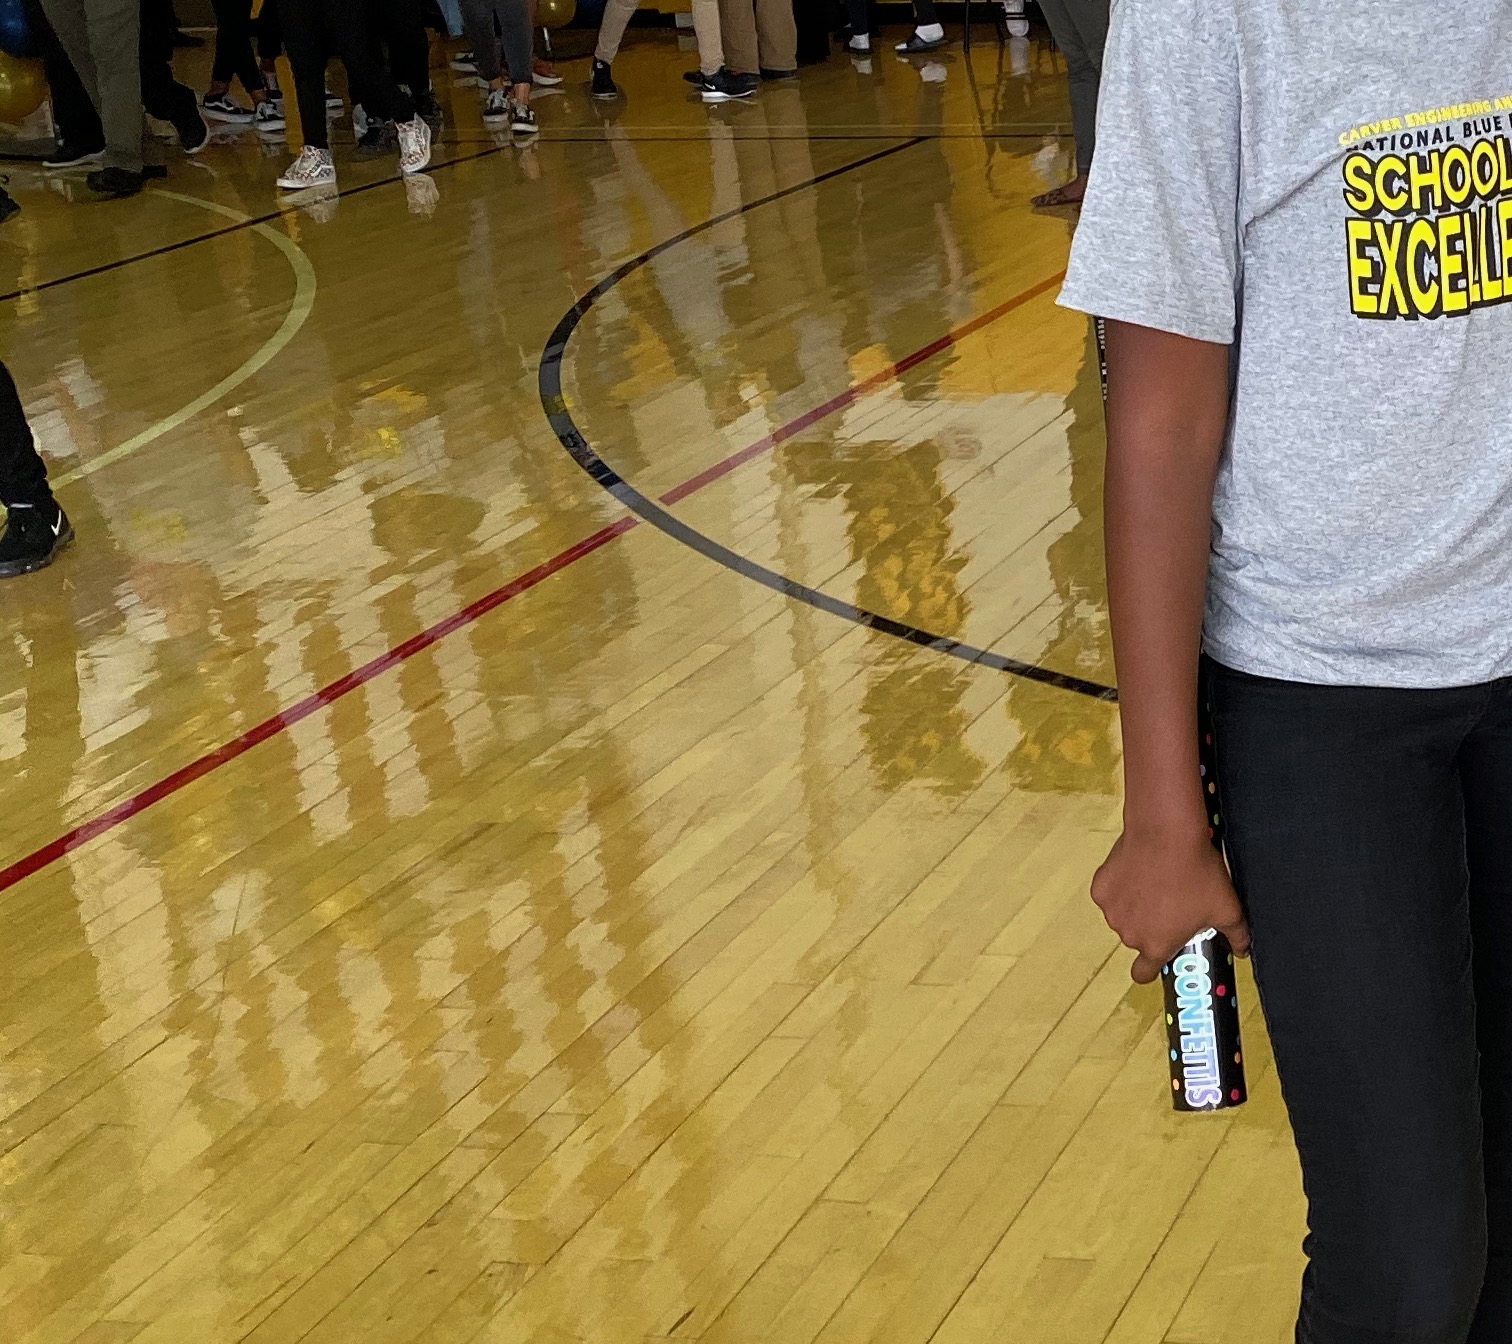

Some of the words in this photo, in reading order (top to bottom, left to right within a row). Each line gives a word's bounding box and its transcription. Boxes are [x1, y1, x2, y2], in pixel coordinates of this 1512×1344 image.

[1338, 117, 1402, 147] CARVER
[1463, 115, 1503, 138] BLUE
[1172, 953, 1223, 1108] CONFETTIS
